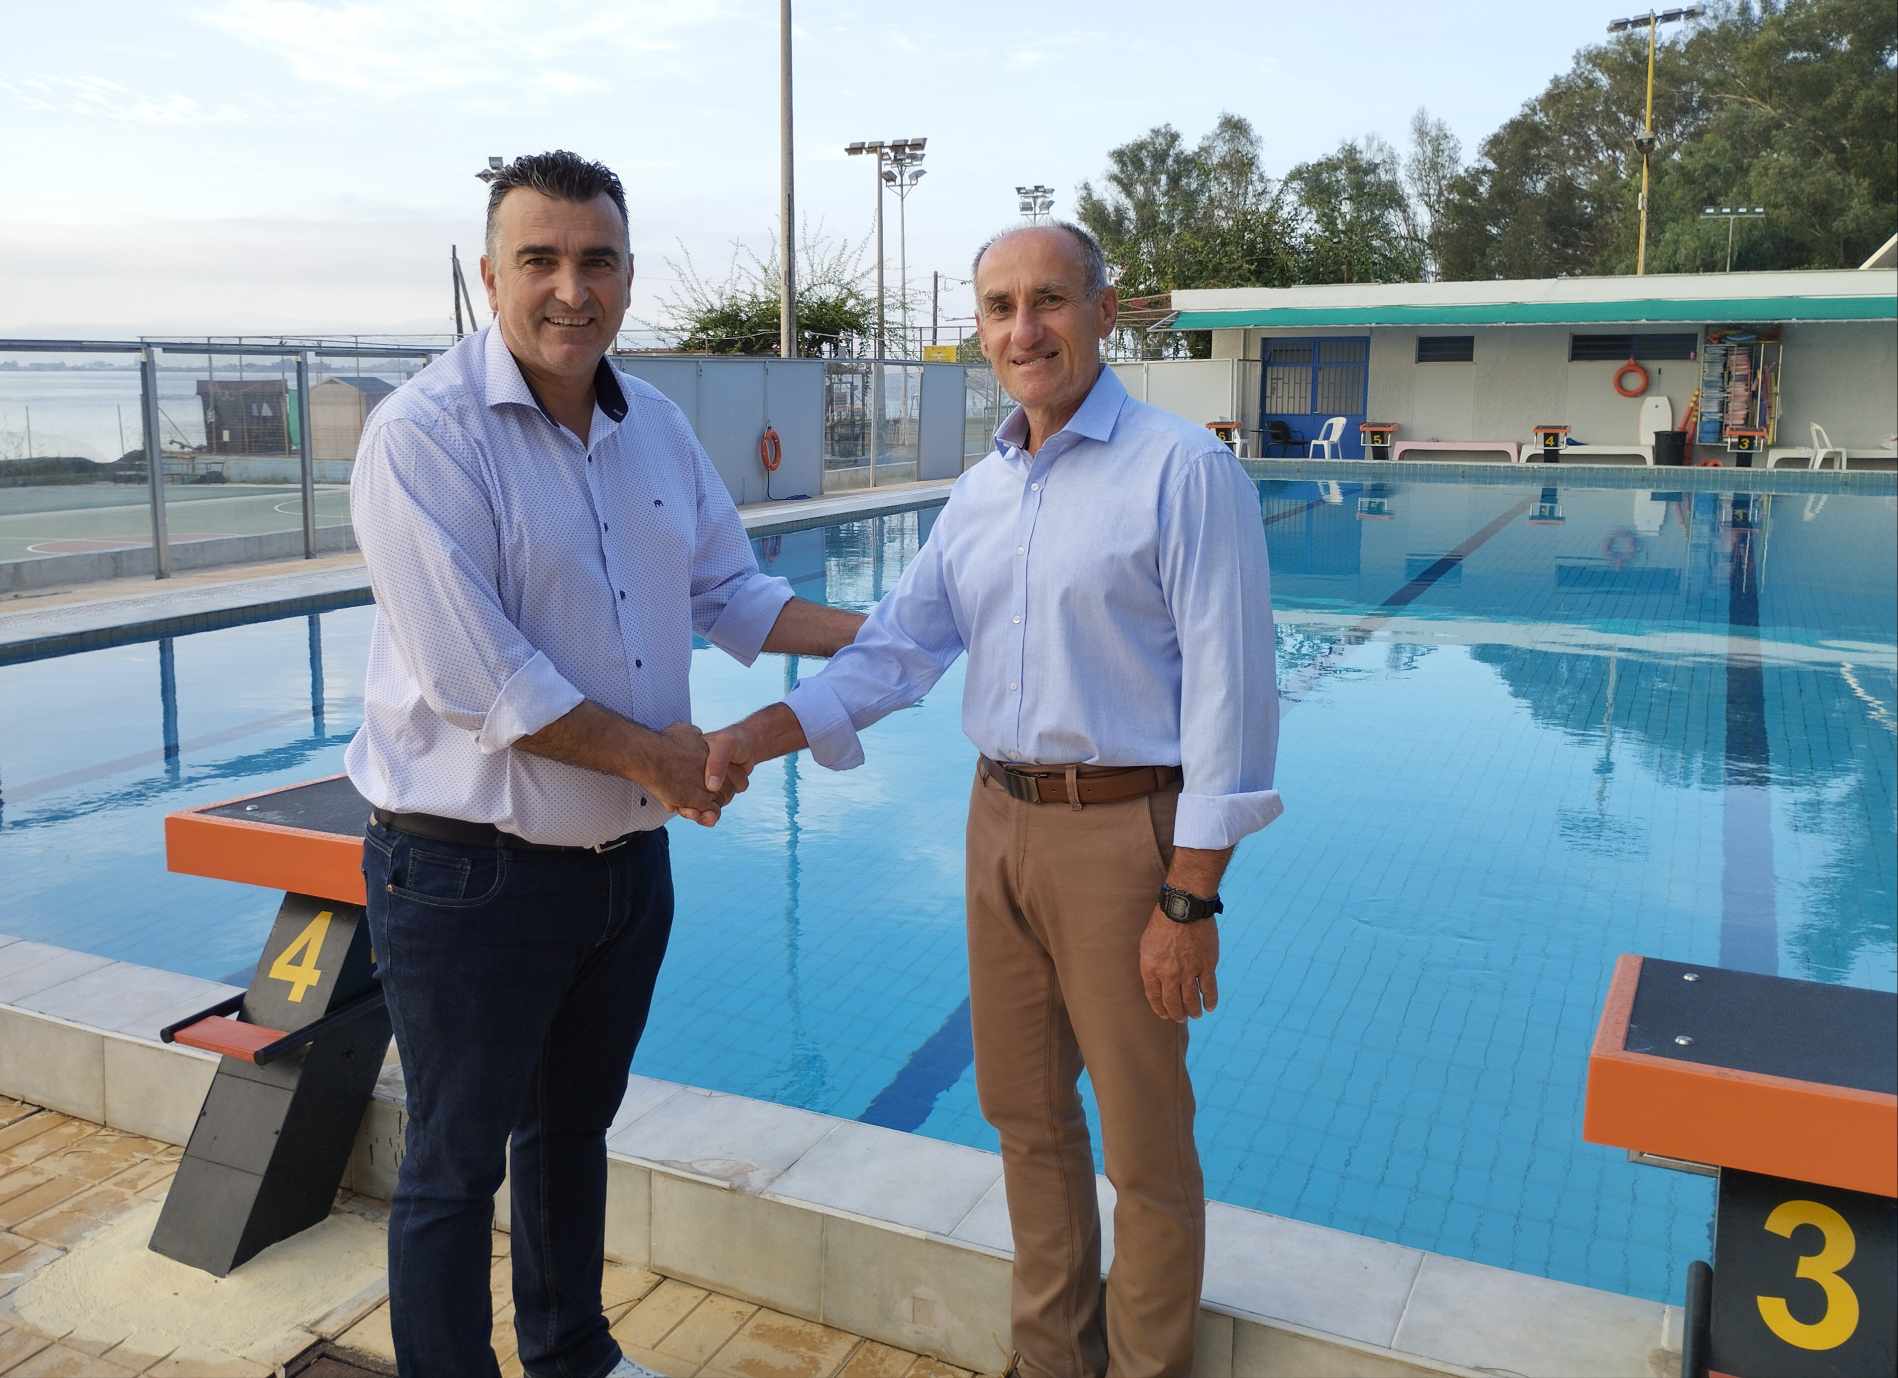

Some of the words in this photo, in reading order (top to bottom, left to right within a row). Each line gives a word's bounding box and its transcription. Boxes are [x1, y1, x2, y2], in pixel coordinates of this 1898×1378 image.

[1373, 435, 1382, 445] 5
[1545, 435, 1554, 447] 4
[1739, 438, 1750, 449] 3
[268, 910, 334, 1004] 4
[1757, 1199, 1860, 1351] 3
